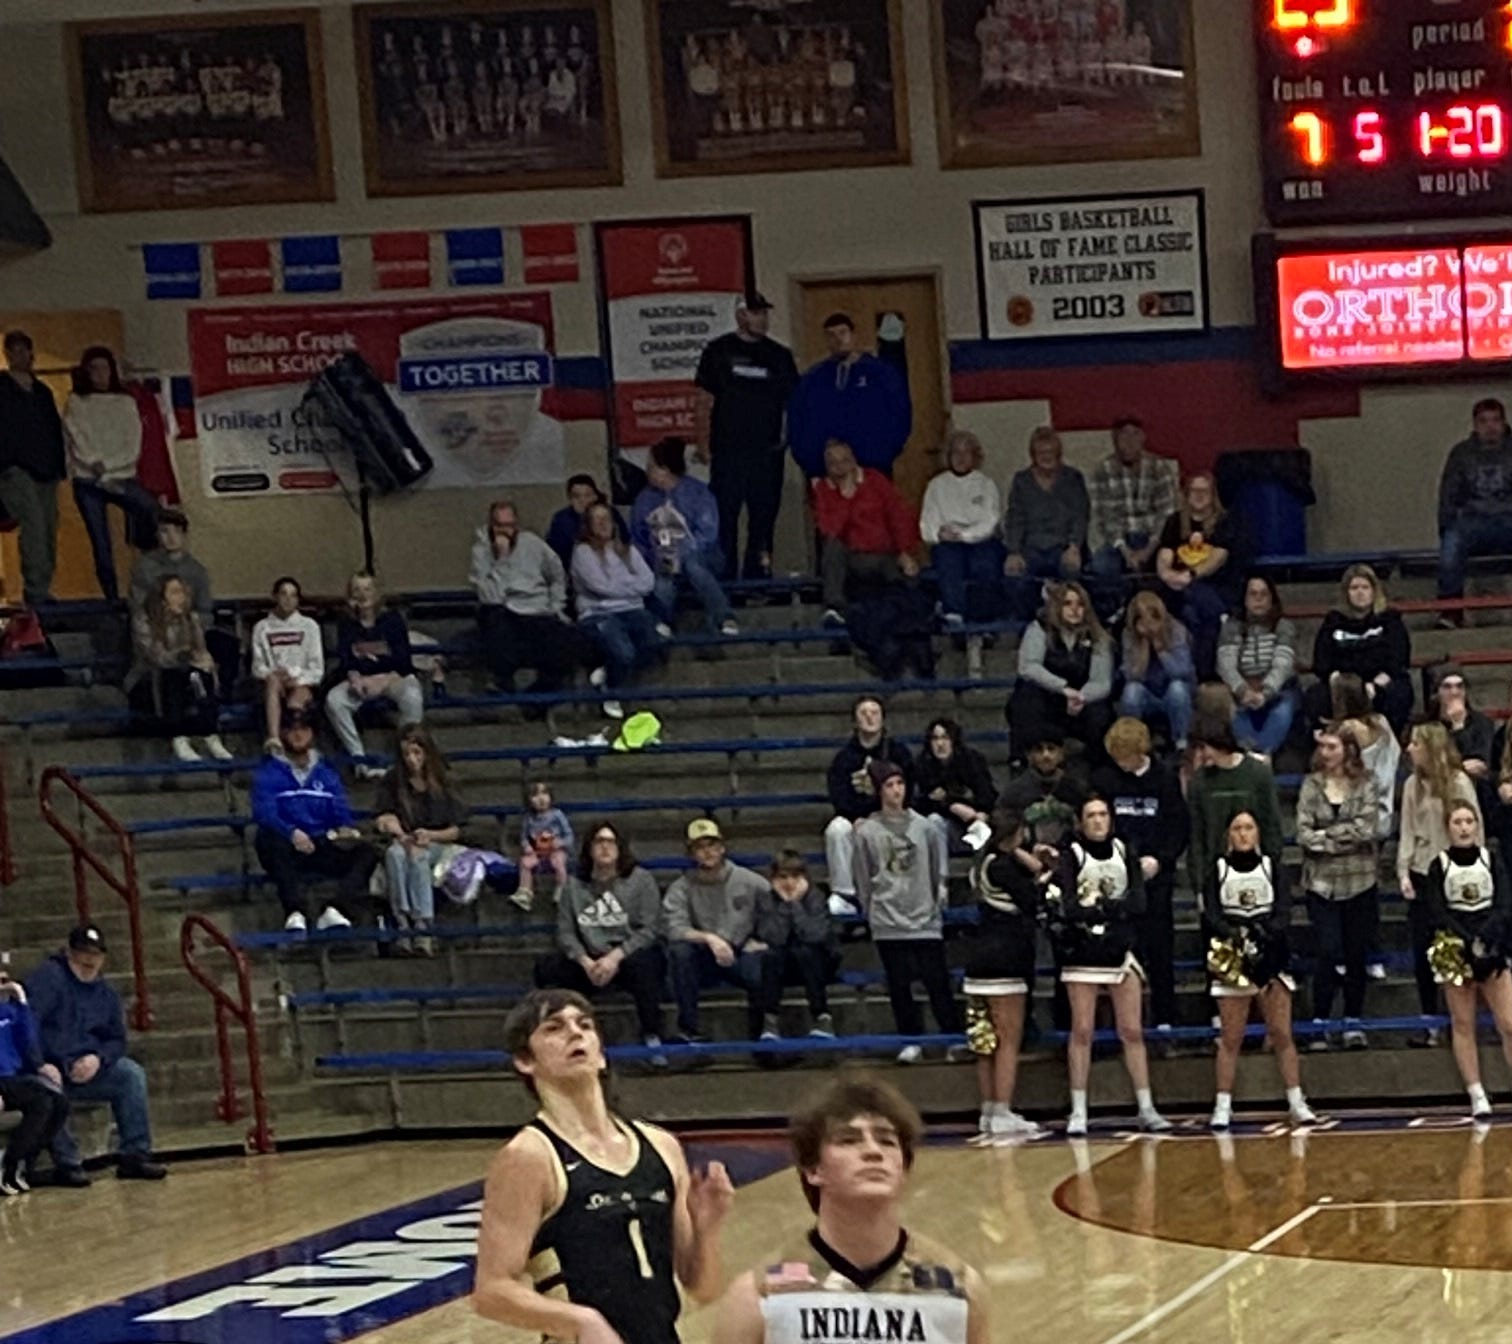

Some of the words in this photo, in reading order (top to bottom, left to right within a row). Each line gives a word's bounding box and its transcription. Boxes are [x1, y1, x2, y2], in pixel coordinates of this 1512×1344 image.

[1411, 19, 1486, 50] period
[1272, 75, 1325, 100] fouls
[1413, 67, 1487, 96] player
[1290, 111, 1326, 166] 7
[1354, 110, 1385, 164] 5
[1282, 180, 1324, 200] won
[1418, 168, 1491, 196] weight
[1005, 212, 1053, 234] GIRLS
[1059, 206, 1174, 231] BASKETBALL
[989, 239, 1034, 261] HALL
[1040, 238, 1061, 259] OF
[1068, 235, 1118, 258] FAME
[1124, 232, 1193, 255] CLASSIC
[1028, 260, 1157, 287] PARTICIPANTS
[1328, 255, 1438, 284] Injured?
[1052, 293, 1126, 321] 2003
[225, 332, 289, 354] Indian
[295, 330, 358, 352] Creek
[639, 338, 707, 355] CHAMPIO
[226, 355, 275, 376] HIGH
[408, 360, 542, 387] TOGETHER
[202, 407, 282, 433] Unified
[268, 434, 346, 457] Schoo
[627, 1218, 654, 1279] 1
[799, 1307, 927, 1342] INDIANA
